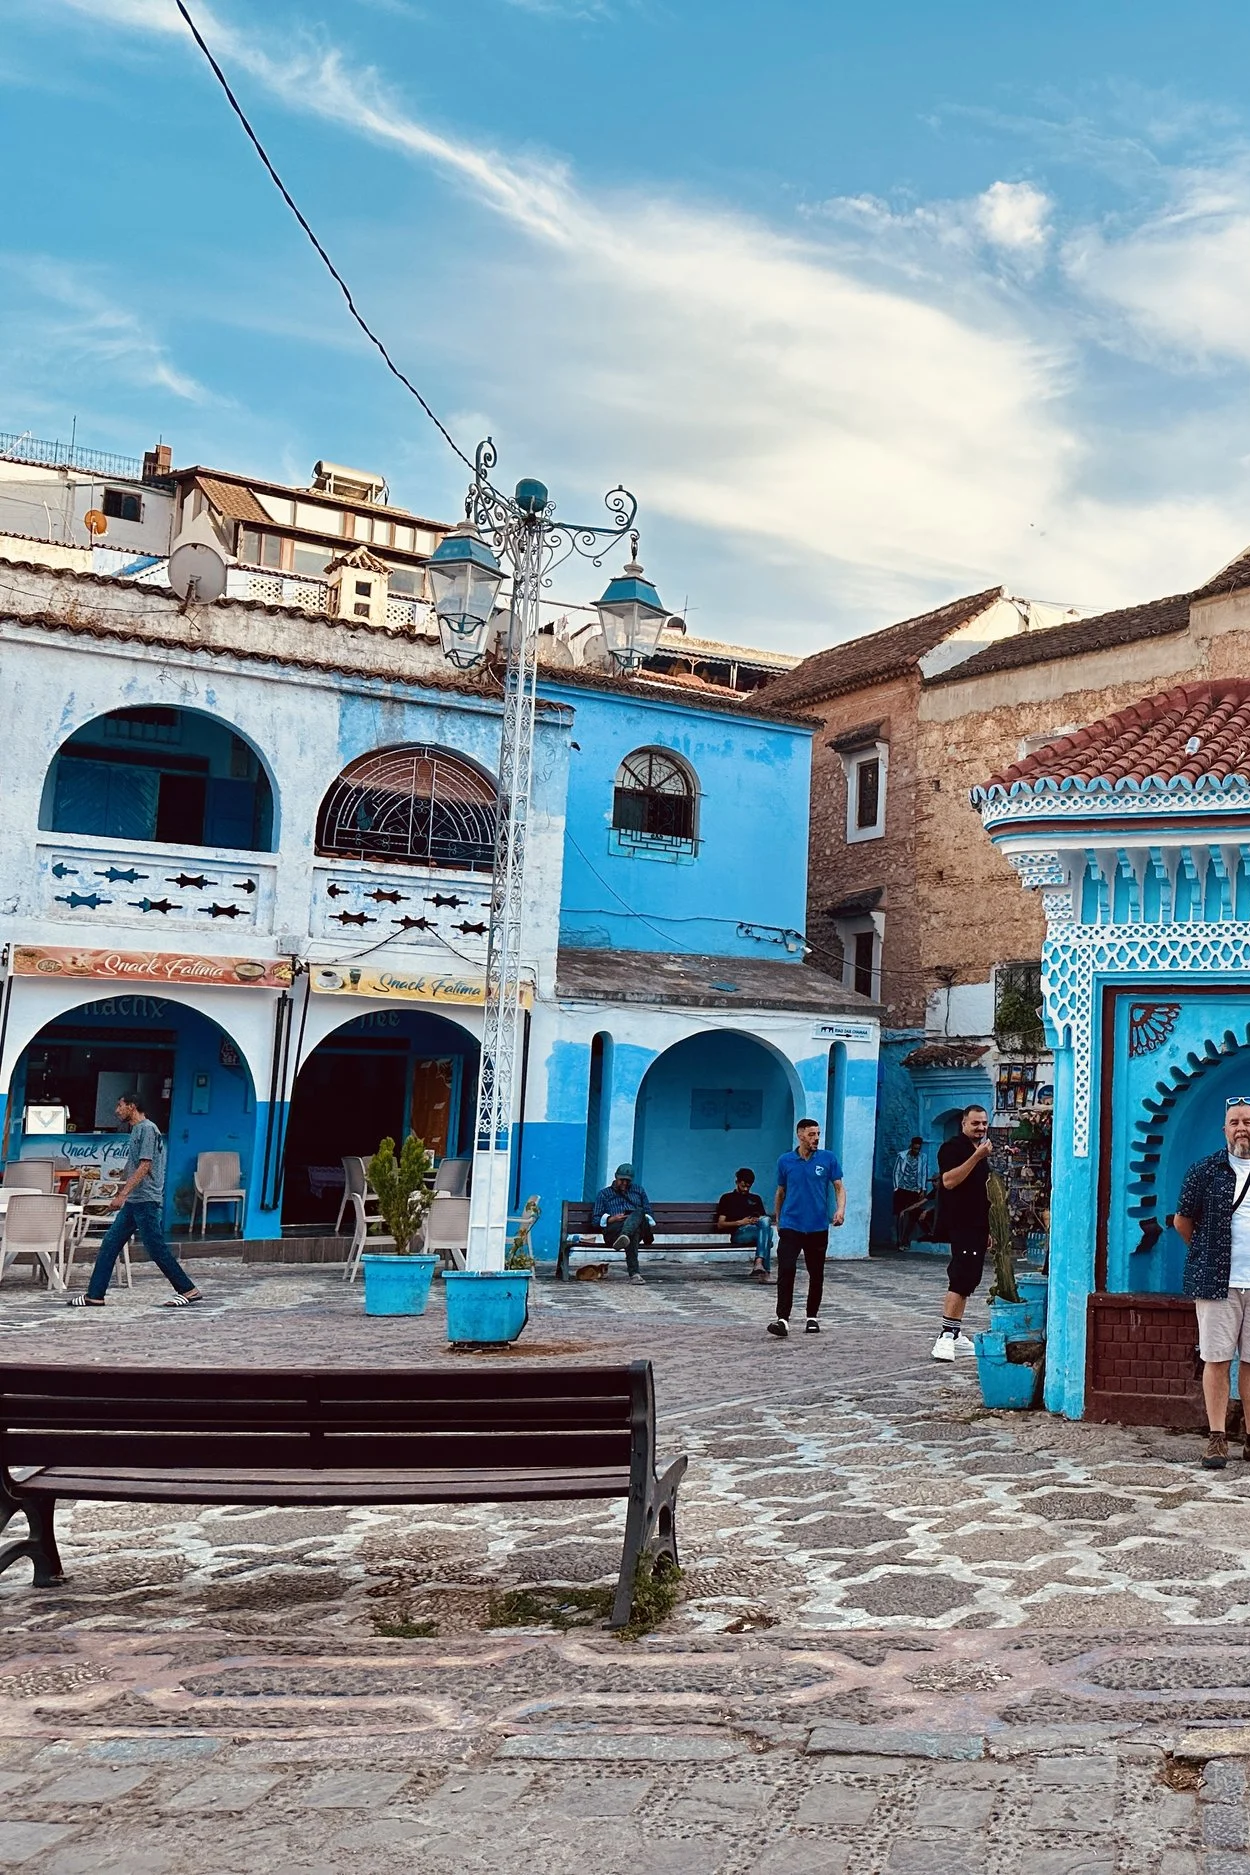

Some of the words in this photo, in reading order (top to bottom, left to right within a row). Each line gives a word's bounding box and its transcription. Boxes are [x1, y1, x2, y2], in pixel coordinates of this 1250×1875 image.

[97, 955, 159, 976] Snack
[162, 958, 224, 979] Fatima
[370, 973, 426, 994] Snack
[431, 978, 482, 997] Fatima
[61, 1141, 98, 1159] Snack
[102, 1141, 130, 1162] Fati
